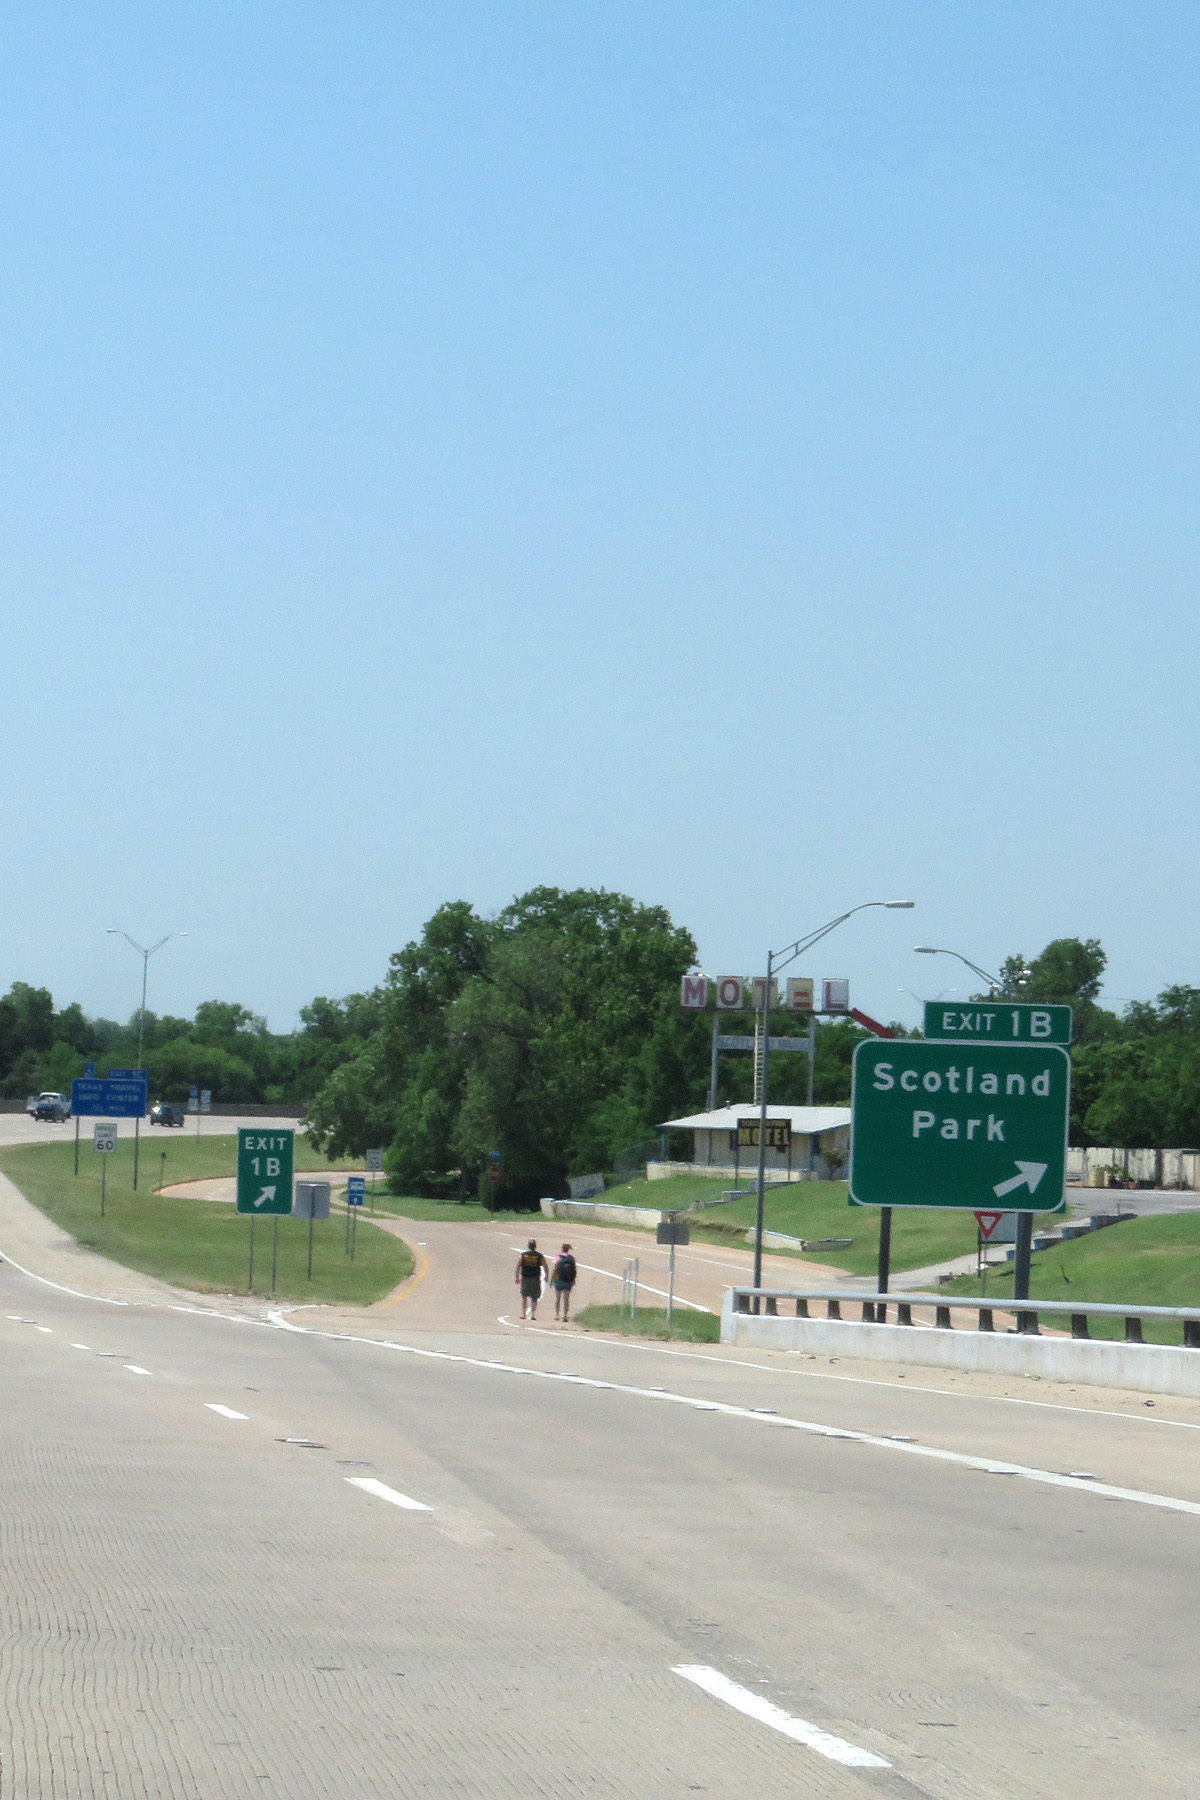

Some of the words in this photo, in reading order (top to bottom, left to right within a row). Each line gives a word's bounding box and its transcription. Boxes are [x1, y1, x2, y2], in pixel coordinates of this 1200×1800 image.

[942, 1012, 996, 1031] EXIT
[1011, 1010, 1051, 1037] 1B
[873, 1062, 1050, 1096] Scotland
[912, 1110, 1005, 1141] Park
[96, 1140, 114, 1150] 60
[244, 1136, 287, 1150] EXIT
[738, 1128, 790, 1145] MOTEL
[251, 1157, 281, 1177] 1B
